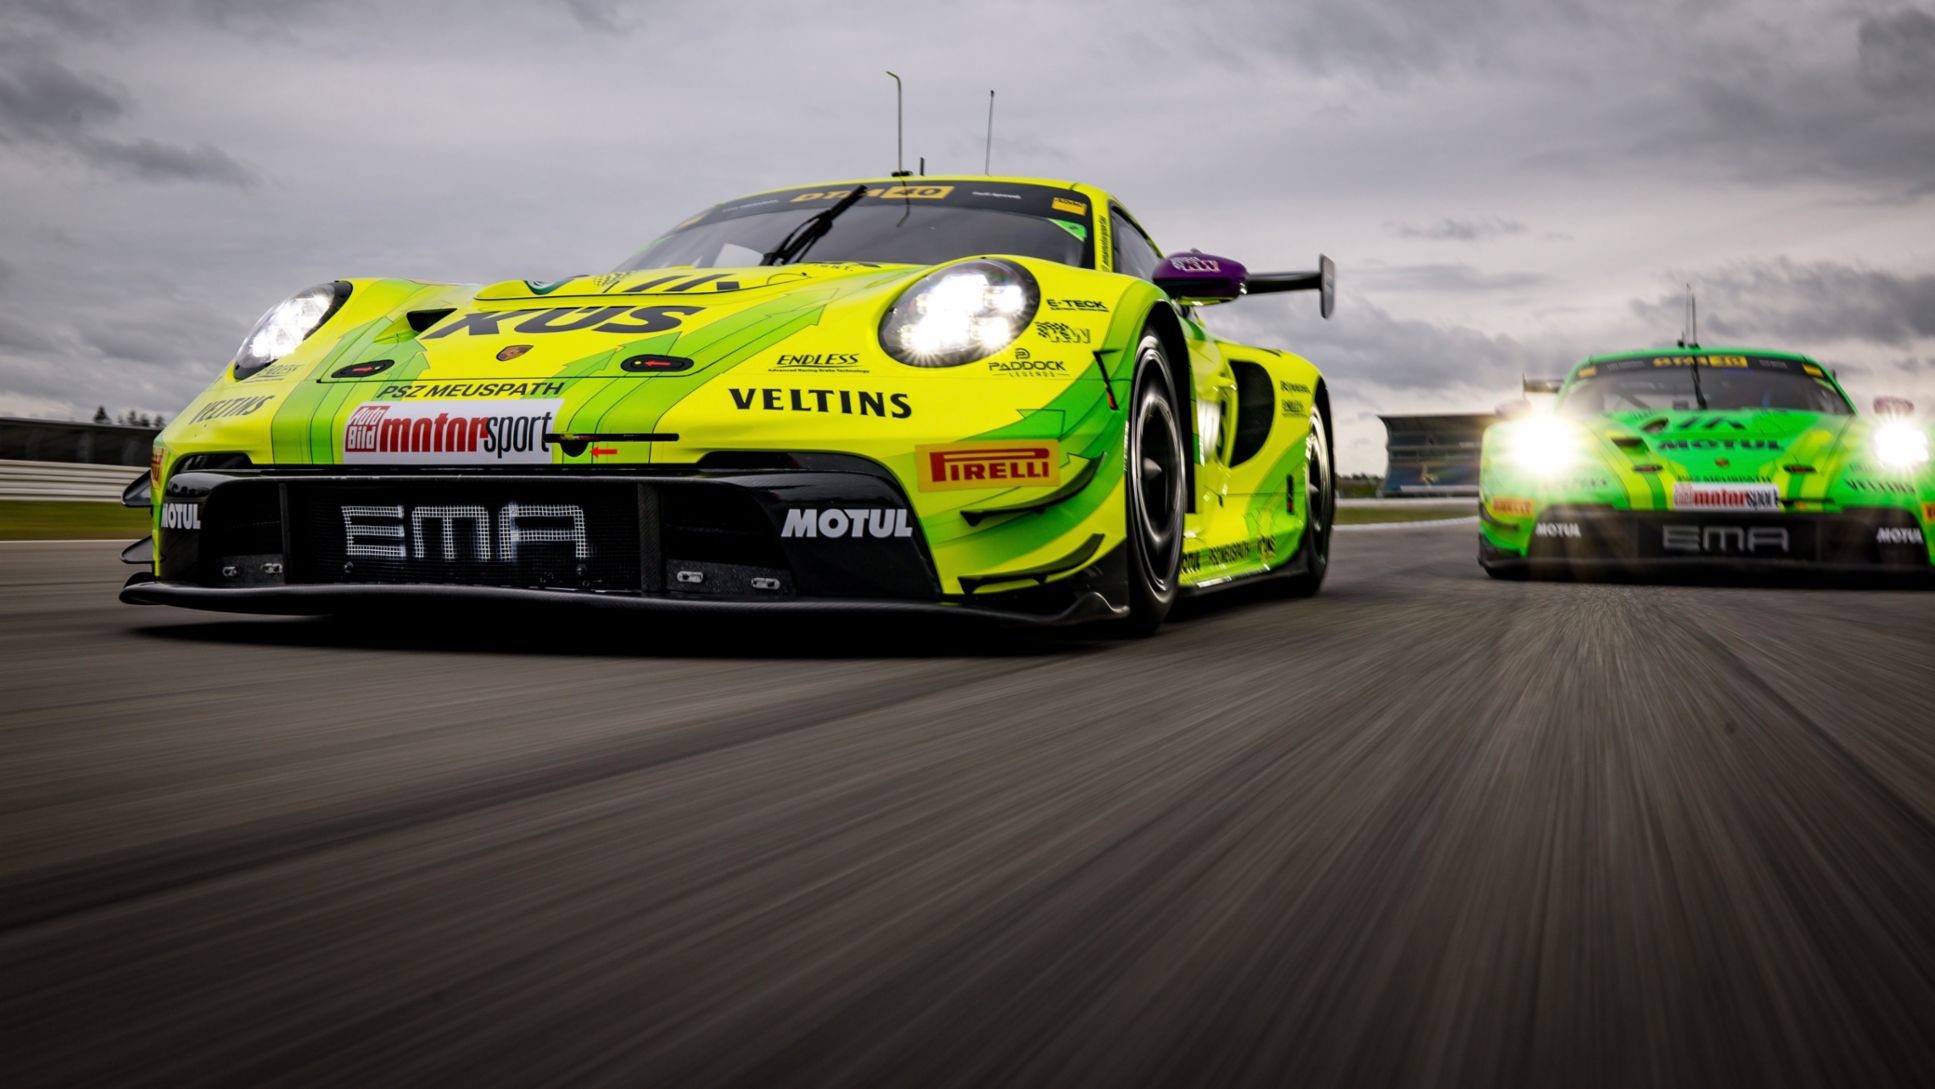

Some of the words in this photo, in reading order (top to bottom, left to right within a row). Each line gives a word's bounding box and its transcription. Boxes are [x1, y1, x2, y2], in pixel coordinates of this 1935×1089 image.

[777, 353, 860, 366] ENDLESS
[989, 360, 1067, 372] PADDOCK
[376, 385, 427, 399] PSZ
[424, 382, 565, 398] MEUSPATH
[350, 406, 385, 426] Auto
[728, 387, 913, 420] VELTINS
[349, 425, 376, 450] Bild
[930, 448, 1050, 483] PIRELLI
[341, 504, 588, 560] EMA
[781, 508, 913, 538] MOTUL
[1535, 522, 1582, 538] MOTUL
[1662, 525, 1789, 552] EMA
